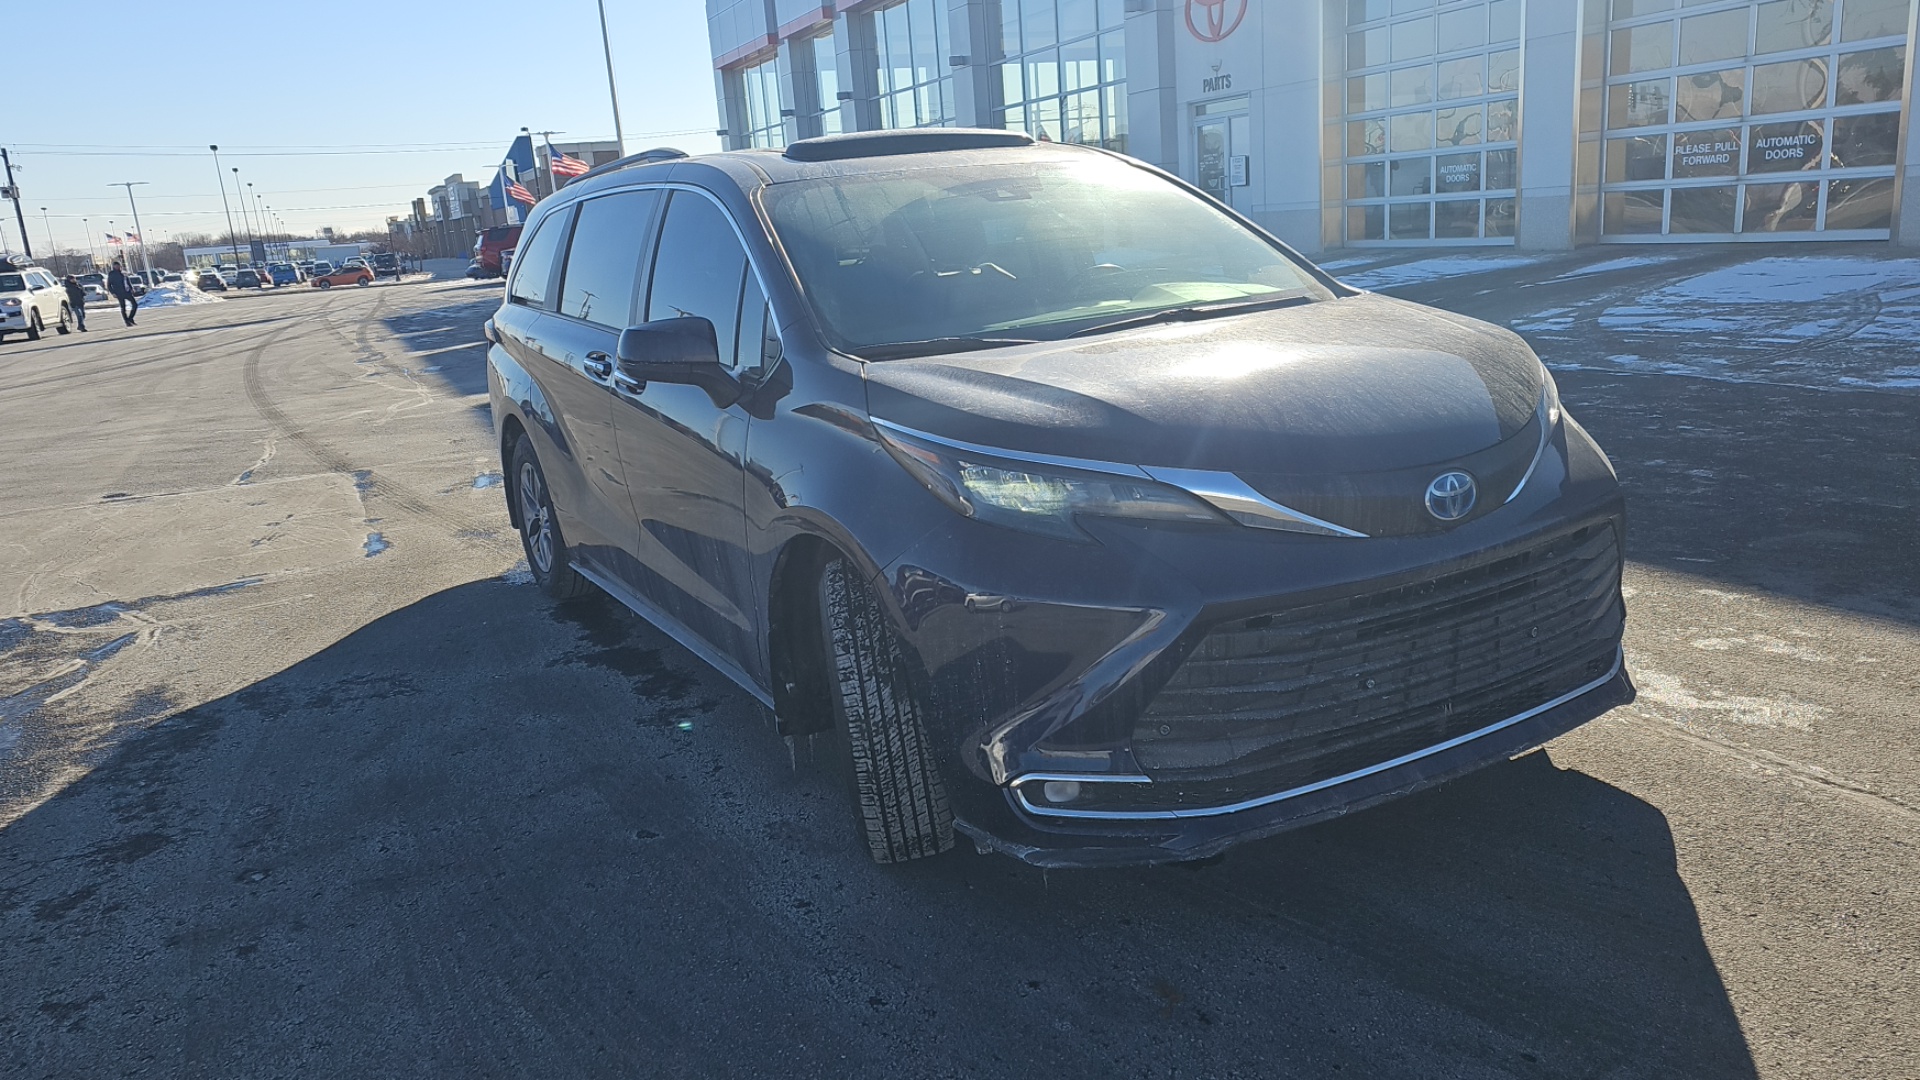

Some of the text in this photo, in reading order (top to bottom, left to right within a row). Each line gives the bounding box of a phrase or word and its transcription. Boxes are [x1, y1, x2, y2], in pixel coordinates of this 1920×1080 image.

[1203, 74, 1232, 93] PARTS
[1756, 134, 1816, 148] AUTOMATIC
[1676, 142, 1739, 155] PLEASE PULL
[1765, 148, 1804, 160] DOORS
[1683, 154, 1730, 166] FORWARD
[1440, 163, 1477, 174] AUTOMATIC
[1446, 173, 1470, 183] DOORS
